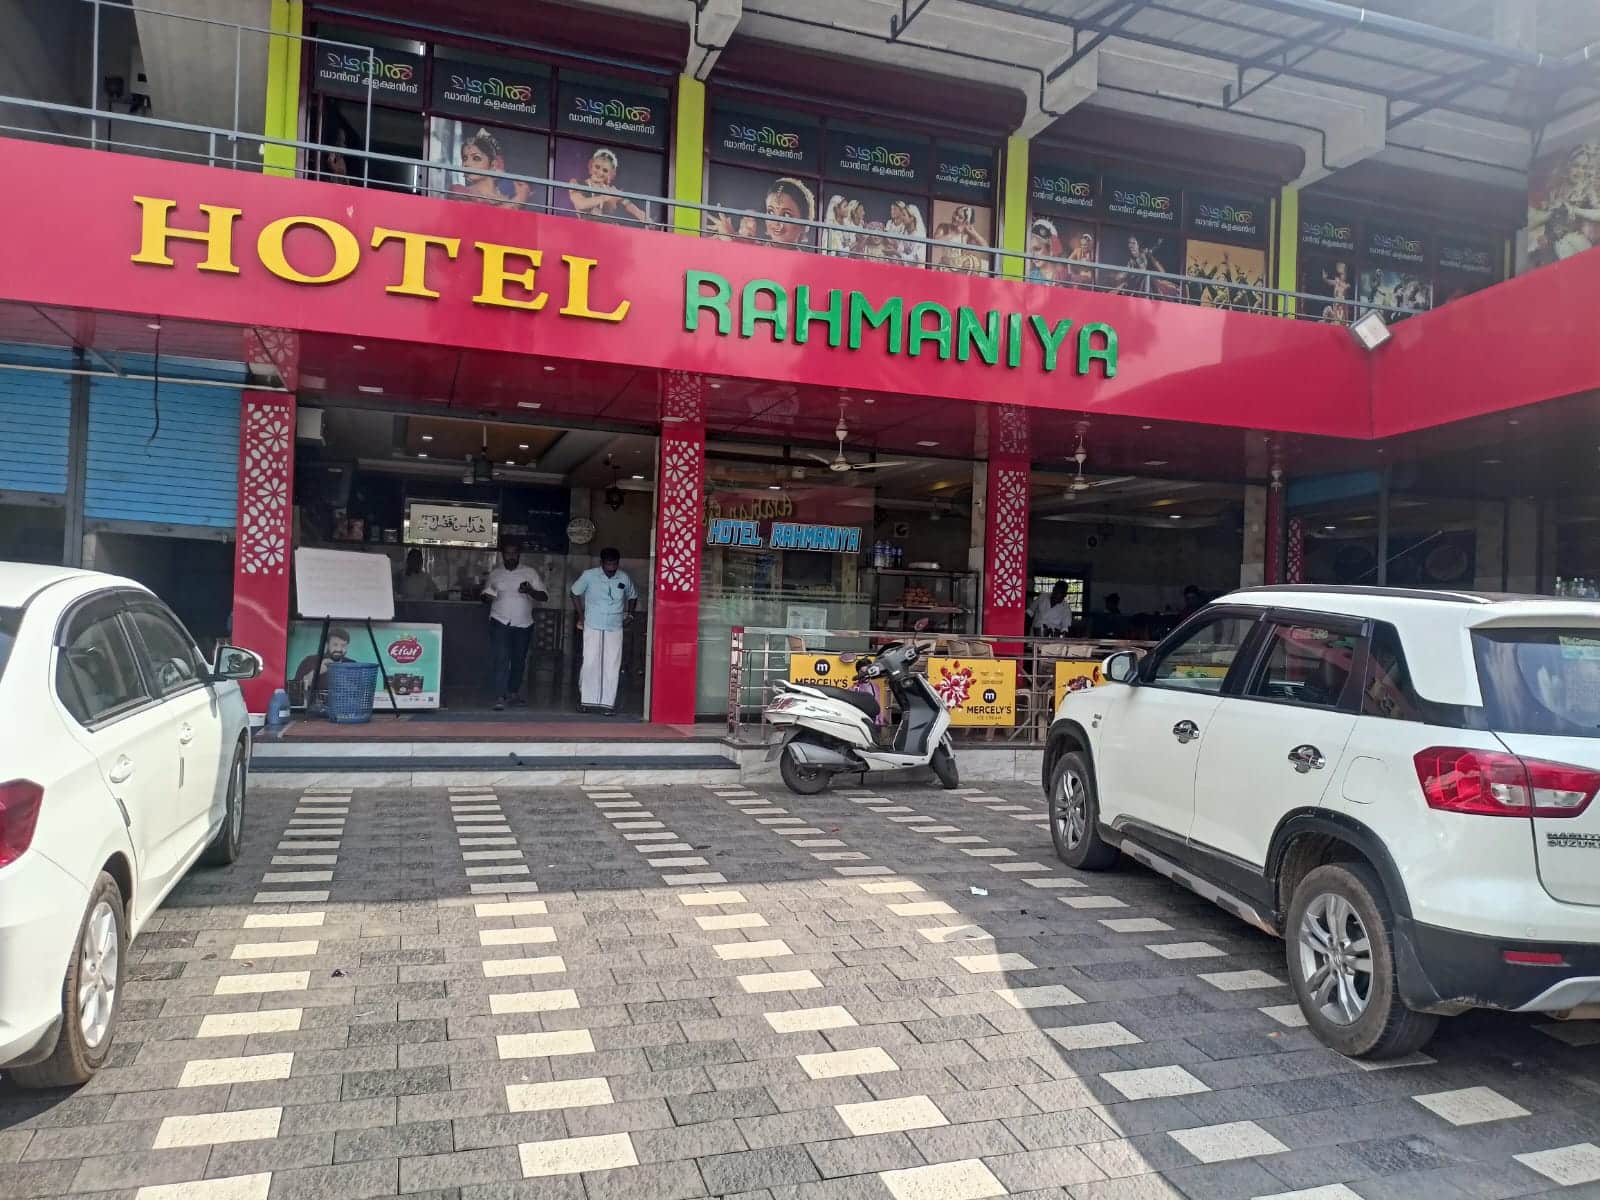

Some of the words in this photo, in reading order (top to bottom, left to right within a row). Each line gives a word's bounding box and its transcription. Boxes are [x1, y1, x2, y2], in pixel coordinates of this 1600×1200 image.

[130, 194, 632, 323] HOTEL
[683, 269, 1119, 379] RAHMANIYA
[707, 518, 763, 548] HOTEL
[769, 522, 863, 553] RAHMANIYA
[795, 677, 848, 688] MERCELY'S
[966, 705, 1012, 714] MERCELY'S
[1547, 839, 1600, 848] SUZUK
